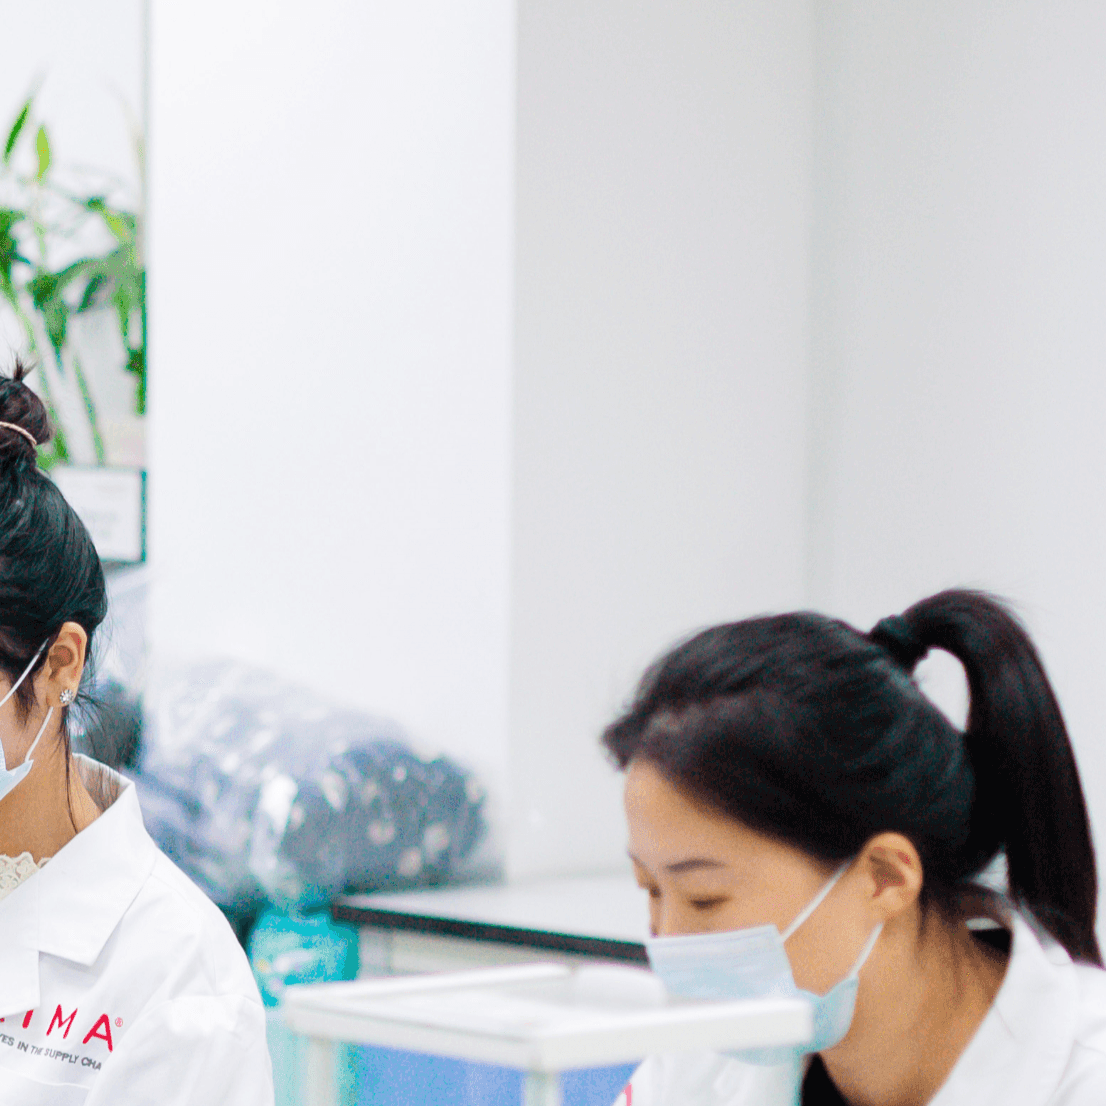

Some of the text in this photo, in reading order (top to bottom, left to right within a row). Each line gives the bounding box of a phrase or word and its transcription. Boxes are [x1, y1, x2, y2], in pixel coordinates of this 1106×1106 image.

[0, 1004, 113, 1052] IMA
[17, 1041, 29, 1052] IN
[44, 1048, 79, 1064] SUPPLY
[81, 1057, 102, 1071] CHA
